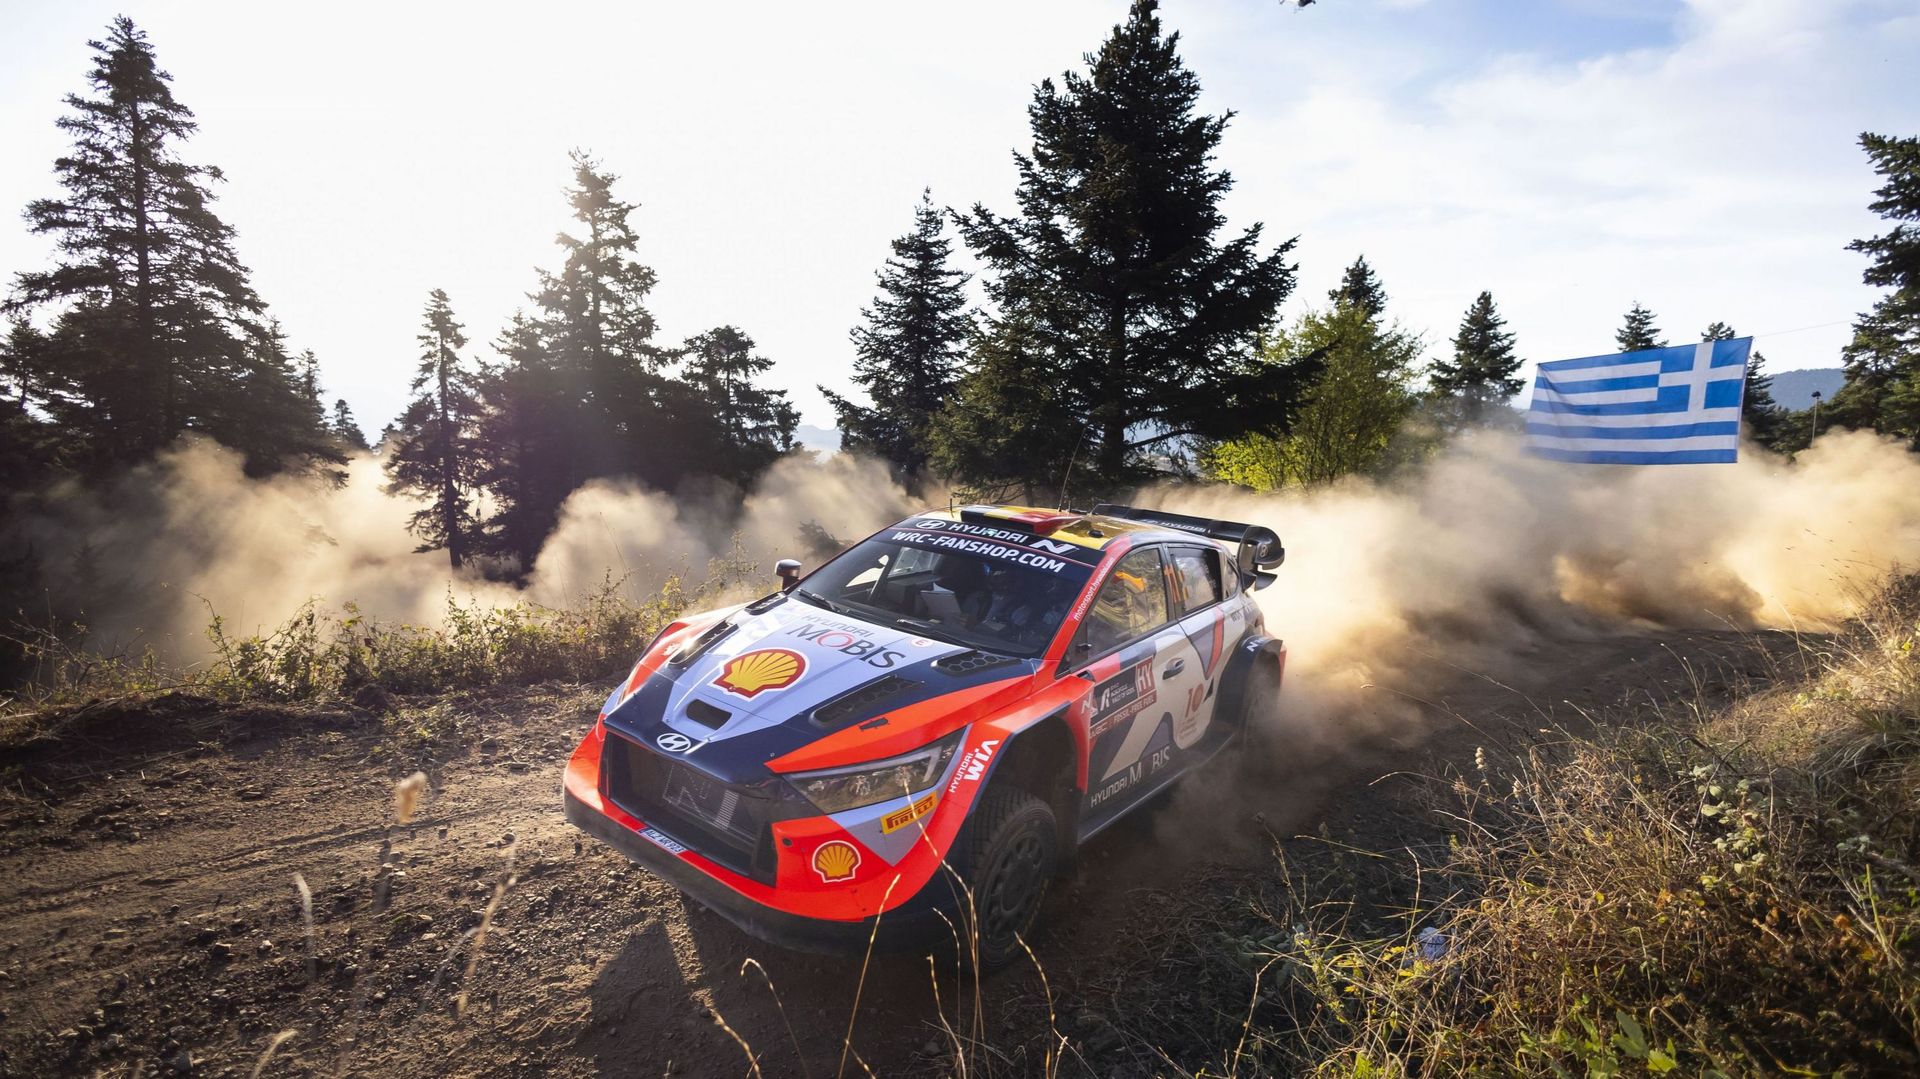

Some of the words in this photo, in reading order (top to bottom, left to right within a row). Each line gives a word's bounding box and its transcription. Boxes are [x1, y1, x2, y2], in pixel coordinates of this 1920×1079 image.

[892, 531, 1067, 573] WRC-FANSHOP.COM
[948, 523, 1029, 543] HYUNDAI
[786, 624, 906, 668] MOBIS
[801, 614, 875, 638] HYUNDAI
[948, 752, 974, 793] HYUNDAI
[1090, 776, 1128, 808] HYUNDAI
[1129, 746, 1170, 786] MBIS
